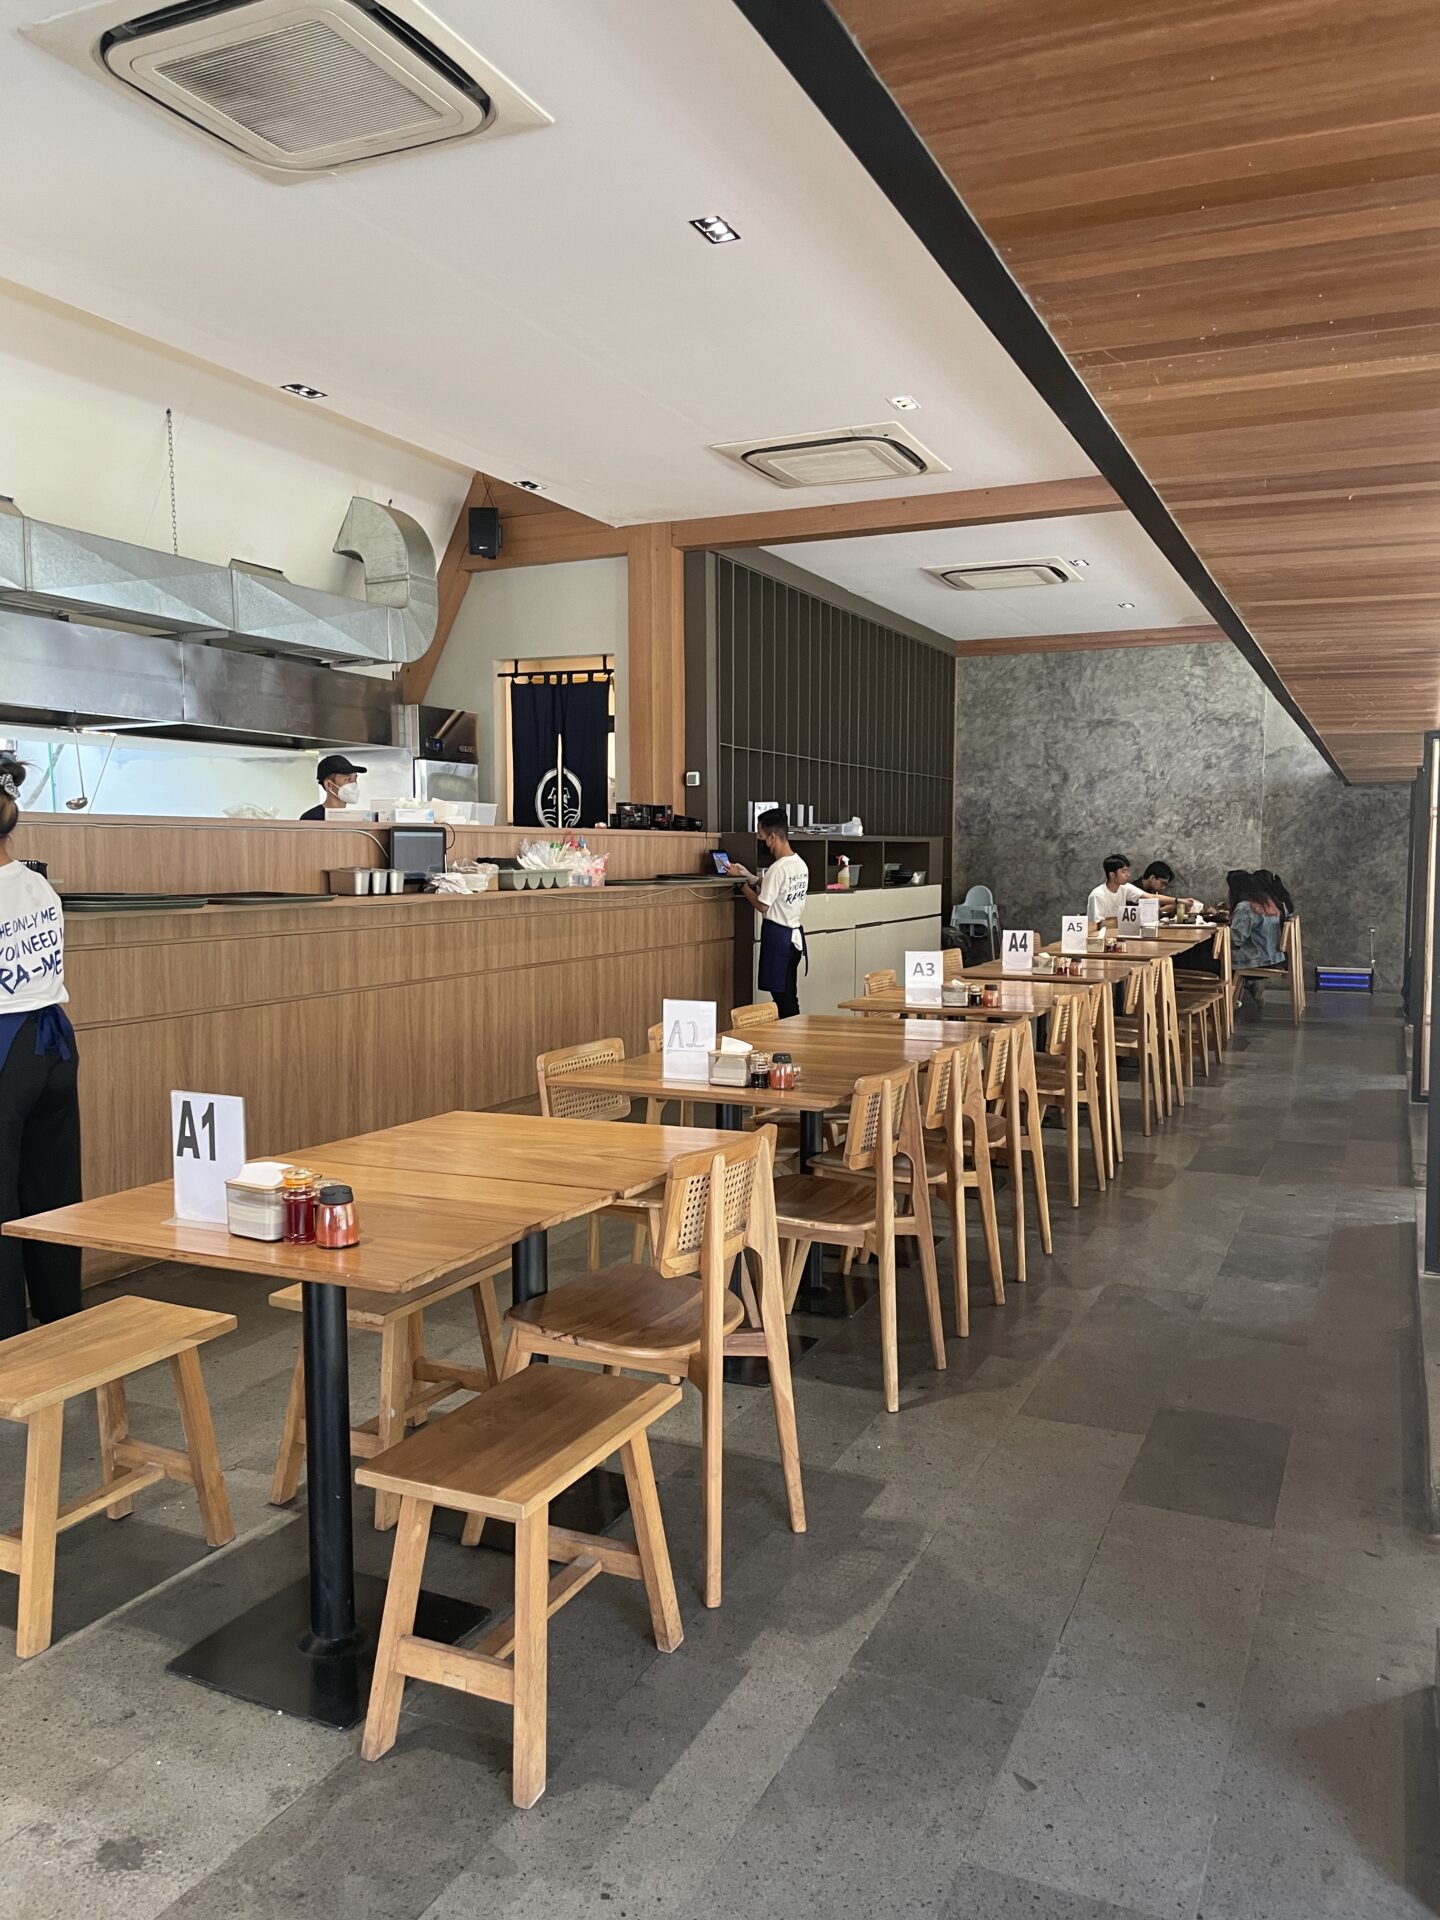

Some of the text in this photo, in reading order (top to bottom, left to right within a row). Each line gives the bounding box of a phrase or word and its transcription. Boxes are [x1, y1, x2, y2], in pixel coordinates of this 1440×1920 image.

[0, 907, 57, 938] HE ONLY ME
[1121, 907, 1137, 922] A6
[1067, 922, 1083, 932] A5
[22, 930, 57, 954] NEED
[1008, 932, 1028, 952] A4
[913, 962, 935, 976] A3
[667, 1020, 704, 1048] A2
[176, 1100, 216, 1161] A1
